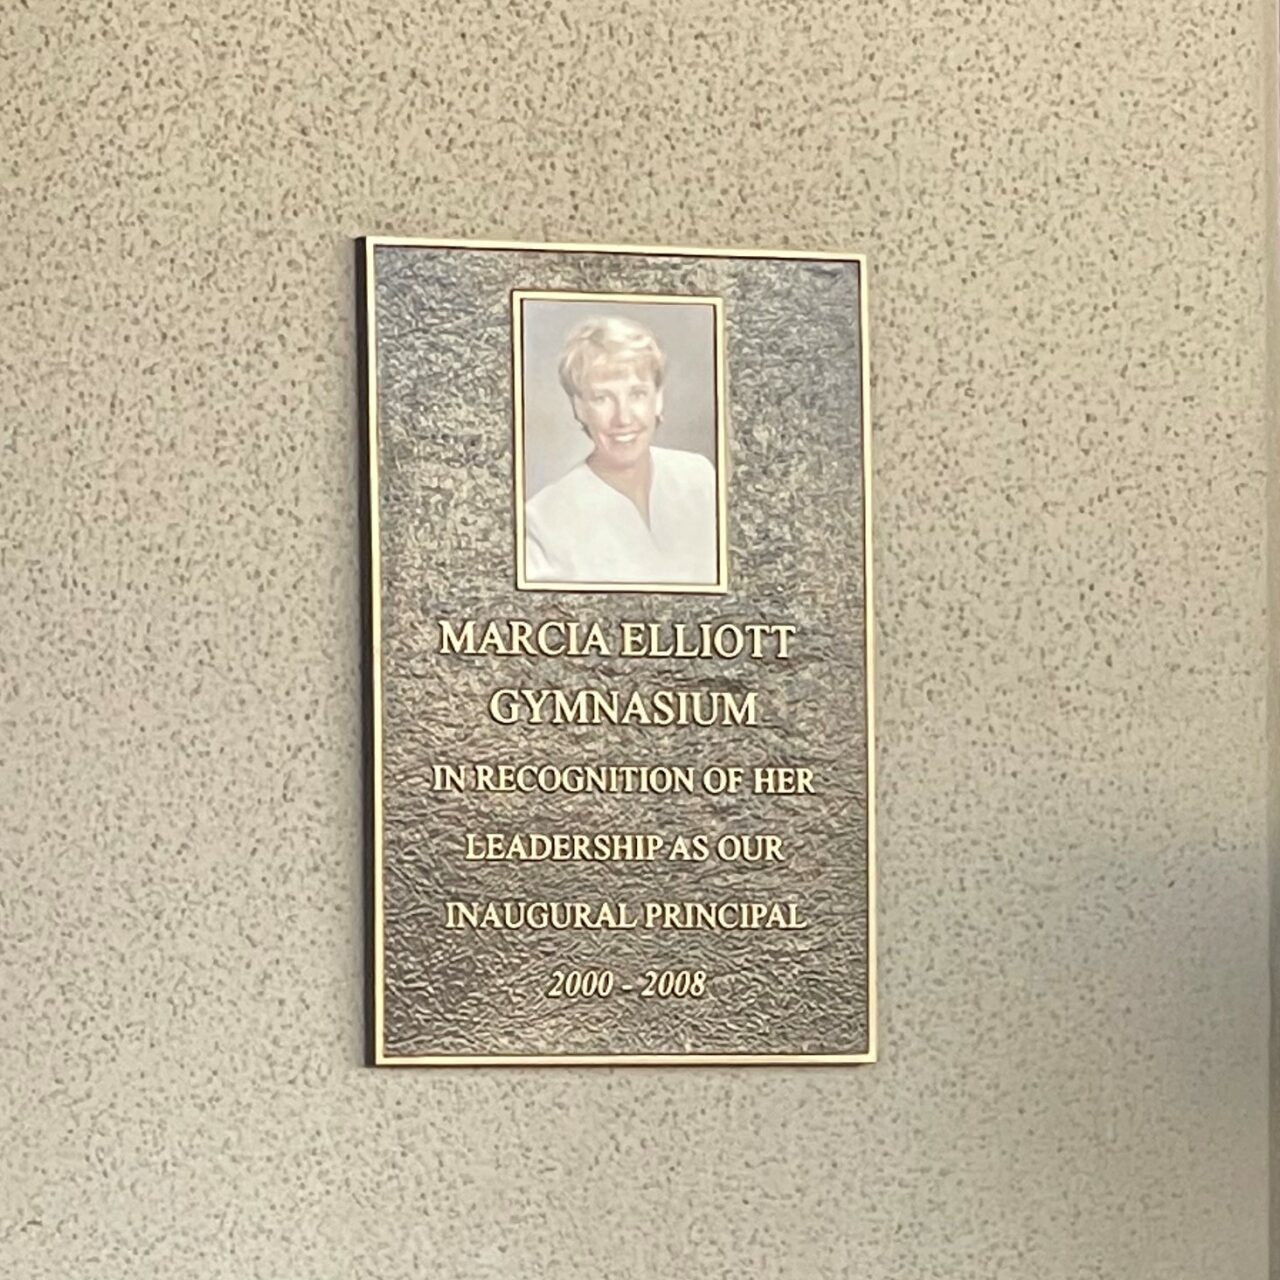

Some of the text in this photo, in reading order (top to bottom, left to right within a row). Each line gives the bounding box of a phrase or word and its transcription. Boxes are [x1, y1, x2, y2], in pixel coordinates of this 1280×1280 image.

[438, 620, 796, 658] MARCIA ELLIOTT
[490, 689, 759, 726] GYMNASIUM
[432, 765, 816, 794] IN RECOGNITION OF HER
[465, 834, 785, 861] LEADERSHIP AS OUR
[445, 903, 807, 929] INAUGURAL PRINCIPAL
[548, 971, 614, 997] 2000
[640, 971, 706, 997] 2008
